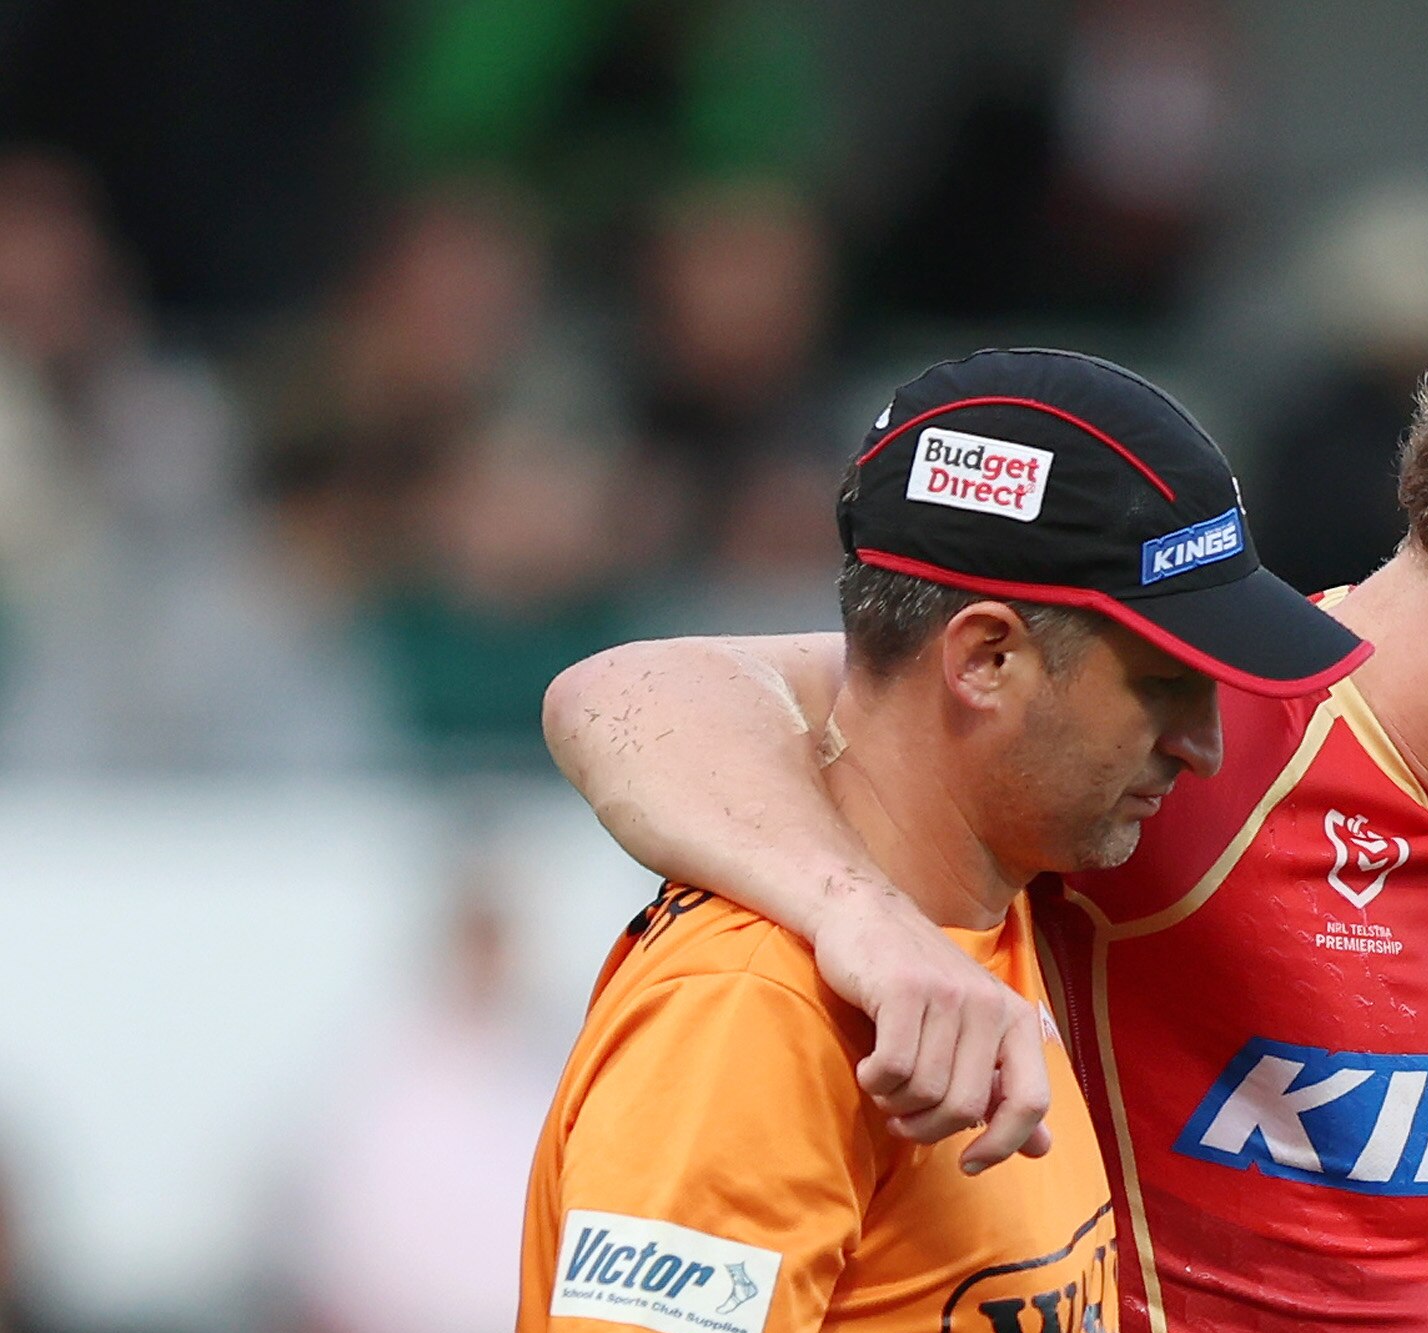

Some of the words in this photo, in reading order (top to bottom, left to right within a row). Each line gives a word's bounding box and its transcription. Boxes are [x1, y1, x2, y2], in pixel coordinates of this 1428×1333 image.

[924, 437, 1040, 483] Budget
[926, 467, 1029, 510] Direct
[1152, 525, 1238, 573] KINGS
[1315, 933, 1403, 955] PREMIERSHIP
[1326, 921, 1349, 935] NRL
[1349, 923, 1393, 939] TELSTRA
[565, 1227, 716, 1299] Victor
[607, 1293, 649, 1308] Sports
[652, 1302, 683, 1318] Club
